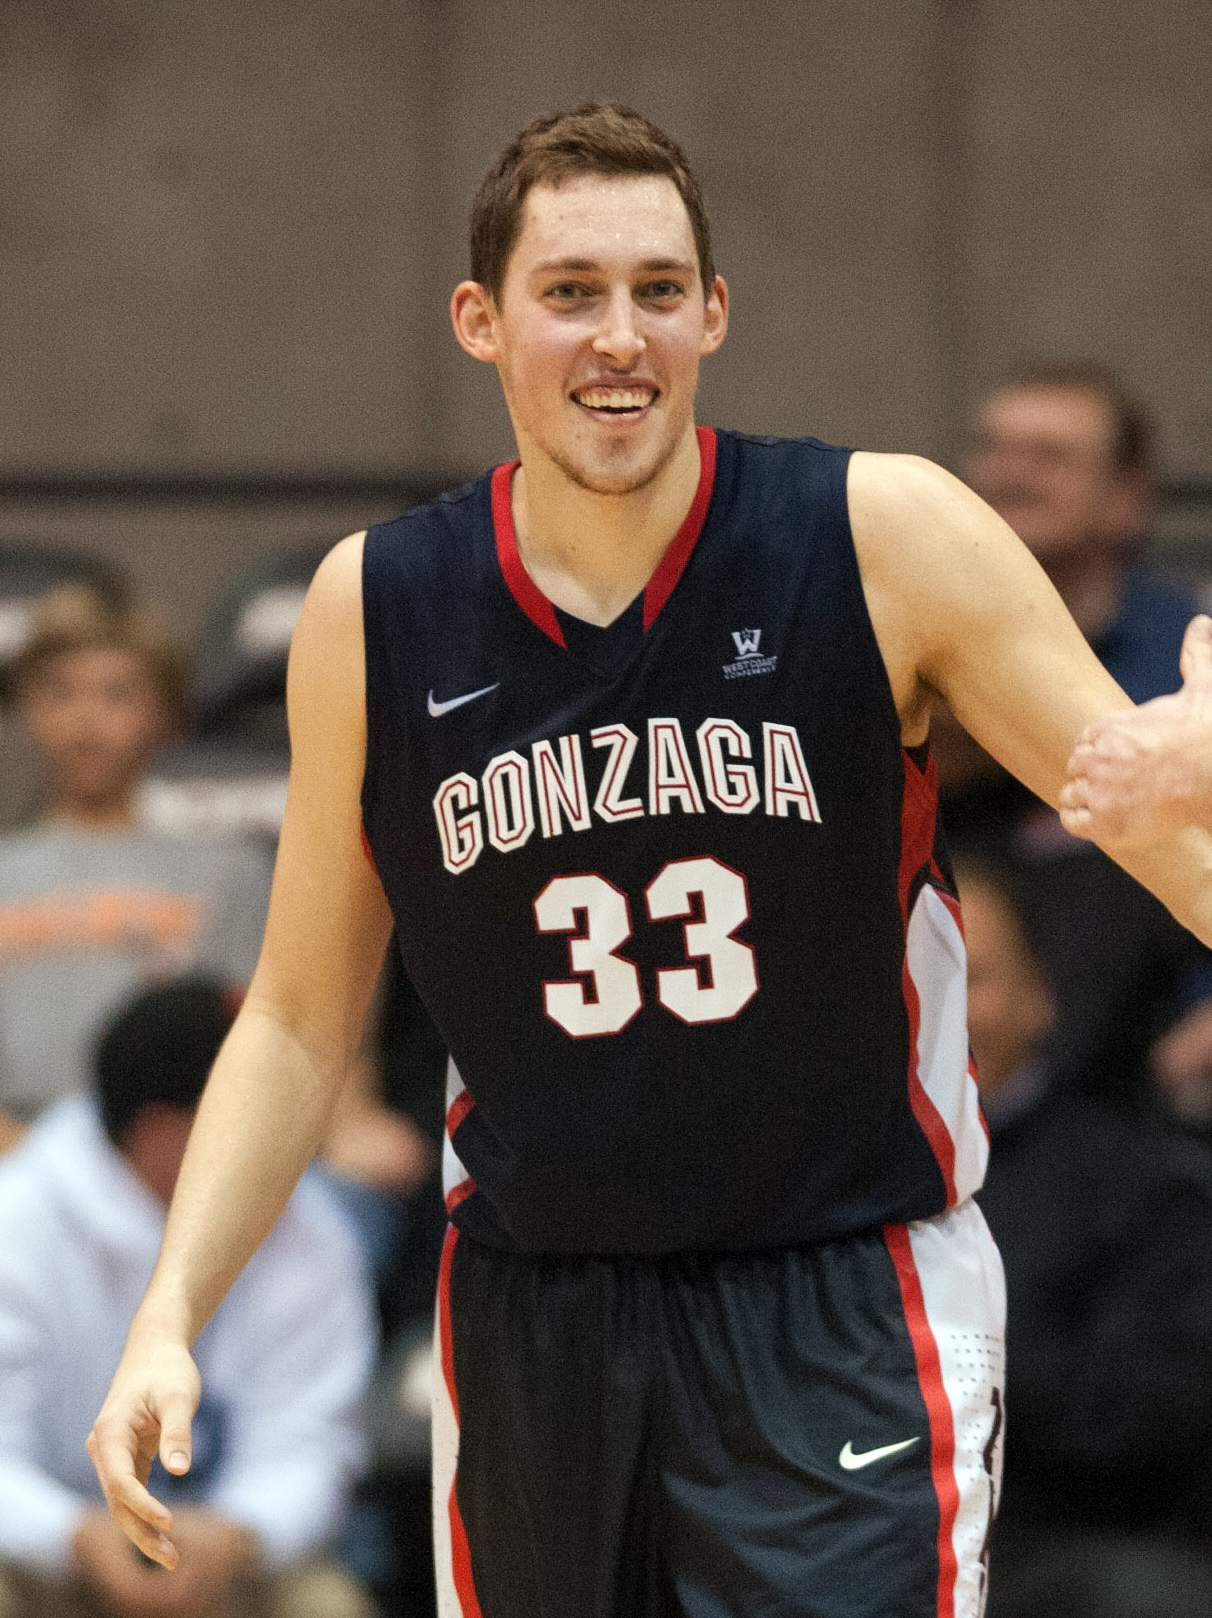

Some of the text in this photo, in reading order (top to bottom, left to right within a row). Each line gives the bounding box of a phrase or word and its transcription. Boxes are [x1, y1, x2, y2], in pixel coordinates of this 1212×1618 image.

[731, 628, 762, 655] W
[433, 717, 822, 874] GONZAGA
[532, 854, 760, 1039] 33
